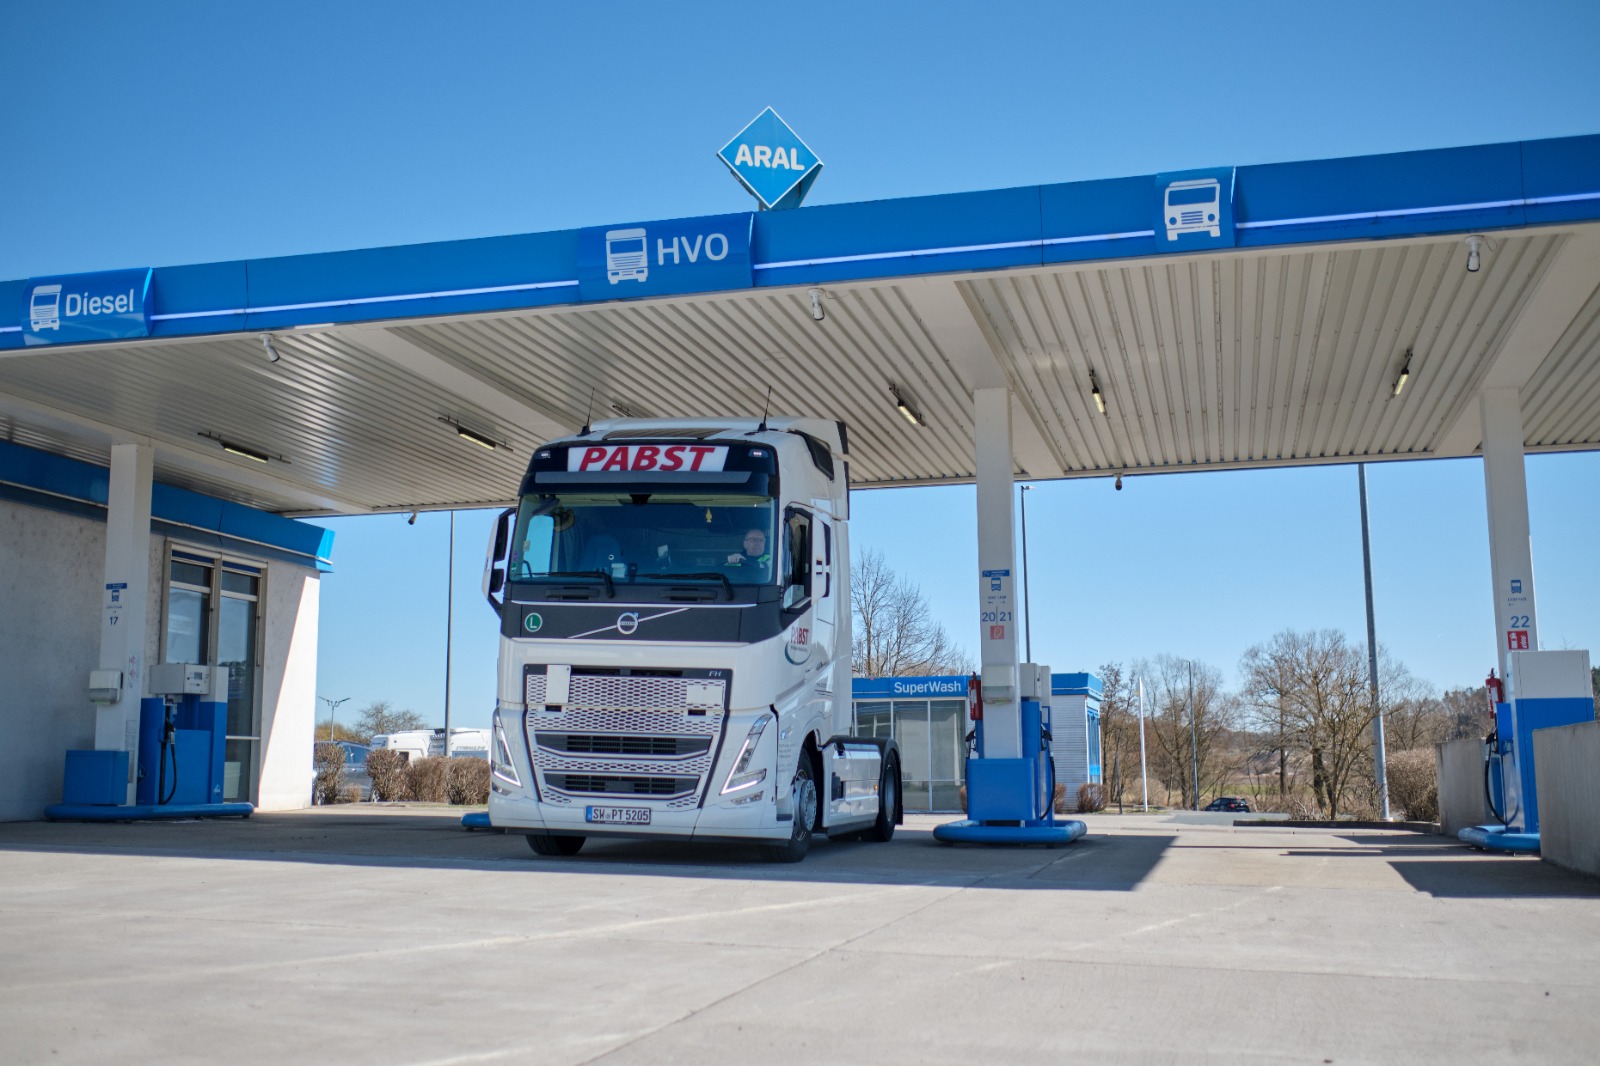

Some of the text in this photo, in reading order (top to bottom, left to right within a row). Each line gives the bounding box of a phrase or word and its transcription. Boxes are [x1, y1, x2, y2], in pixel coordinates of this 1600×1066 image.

[735, 144, 805, 171] ARAL
[657, 233, 728, 266] HVO
[65, 288, 134, 317] Diesel
[578, 446, 716, 472] PABST
[109, 616, 119, 625] 17
[530, 616, 538, 629] L
[982, 611, 1012, 622] 20 21
[1510, 615, 1530, 628] 22
[894, 680, 962, 696] SuperWash
[625, 809, 649, 822] 5205
